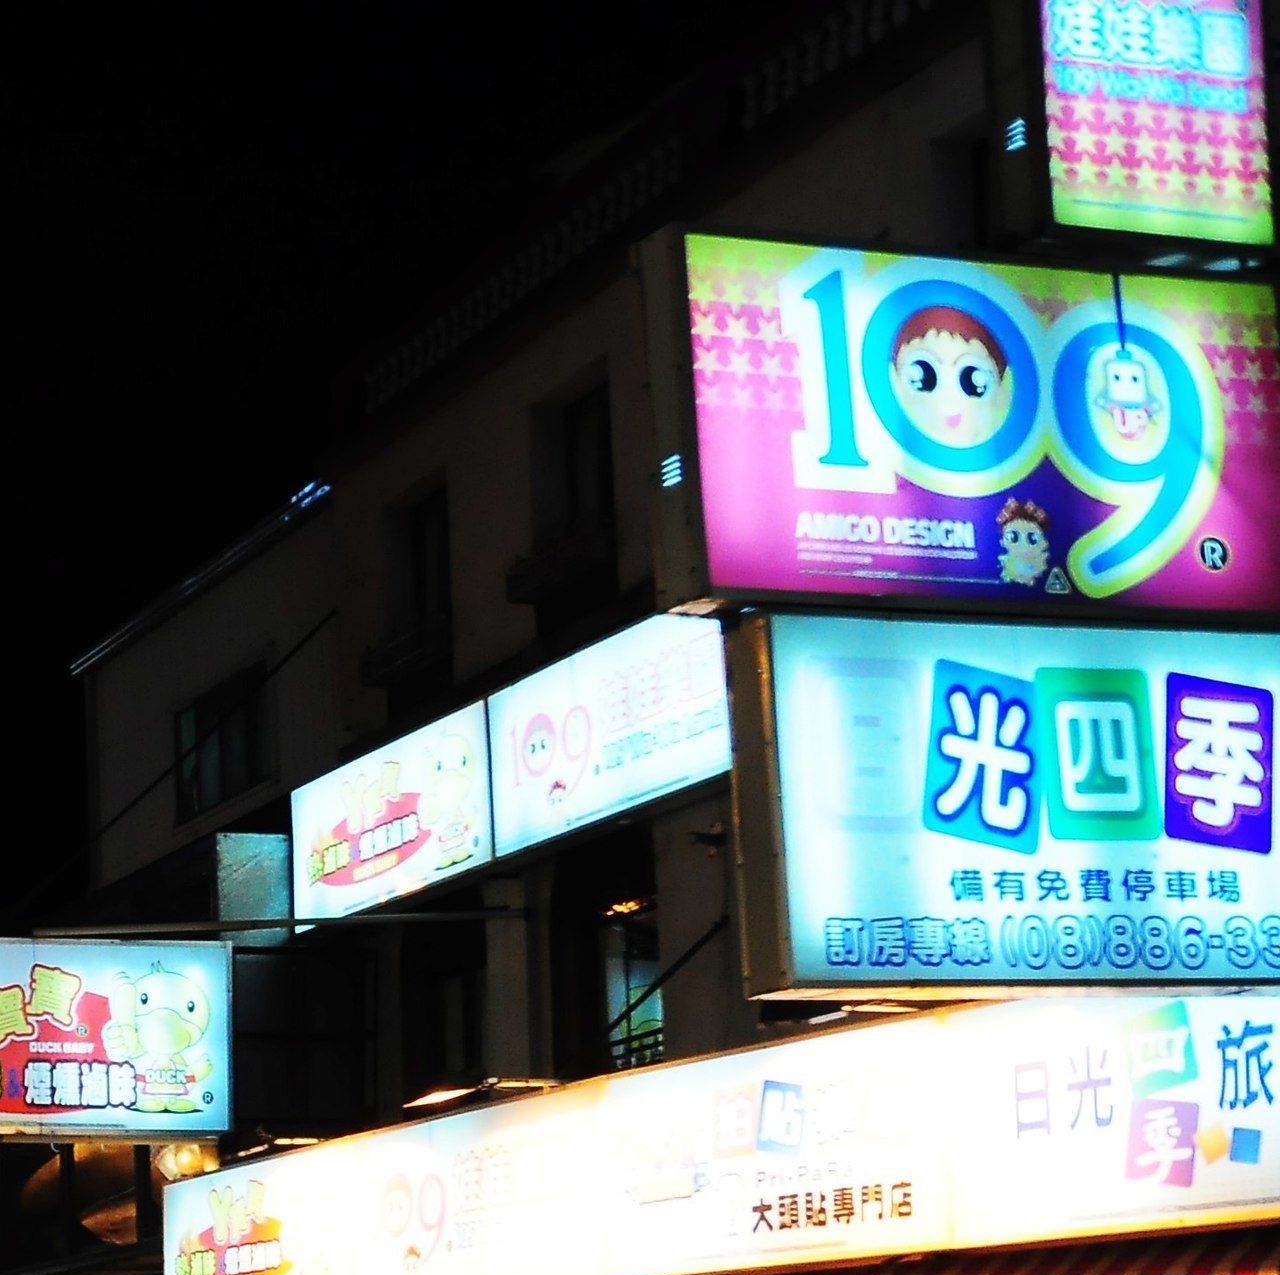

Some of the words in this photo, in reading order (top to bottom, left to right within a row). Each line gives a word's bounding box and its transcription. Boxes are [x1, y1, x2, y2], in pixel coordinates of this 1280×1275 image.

[801, 268, 1205, 578] 109
[795, 512, 881, 543] AMIGO
[881, 516, 976, 549] DESIGN
[950, 869, 1241, 902] 備有免費停車場
[826, 917, 991, 966] 訂房專線
[29, 1041, 62, 1054] DUCK
[63, 1042, 96, 1055] BABY
[145, 1067, 187, 1085] DUCK
[751, 1181, 913, 1234] 大頭貼專門店
